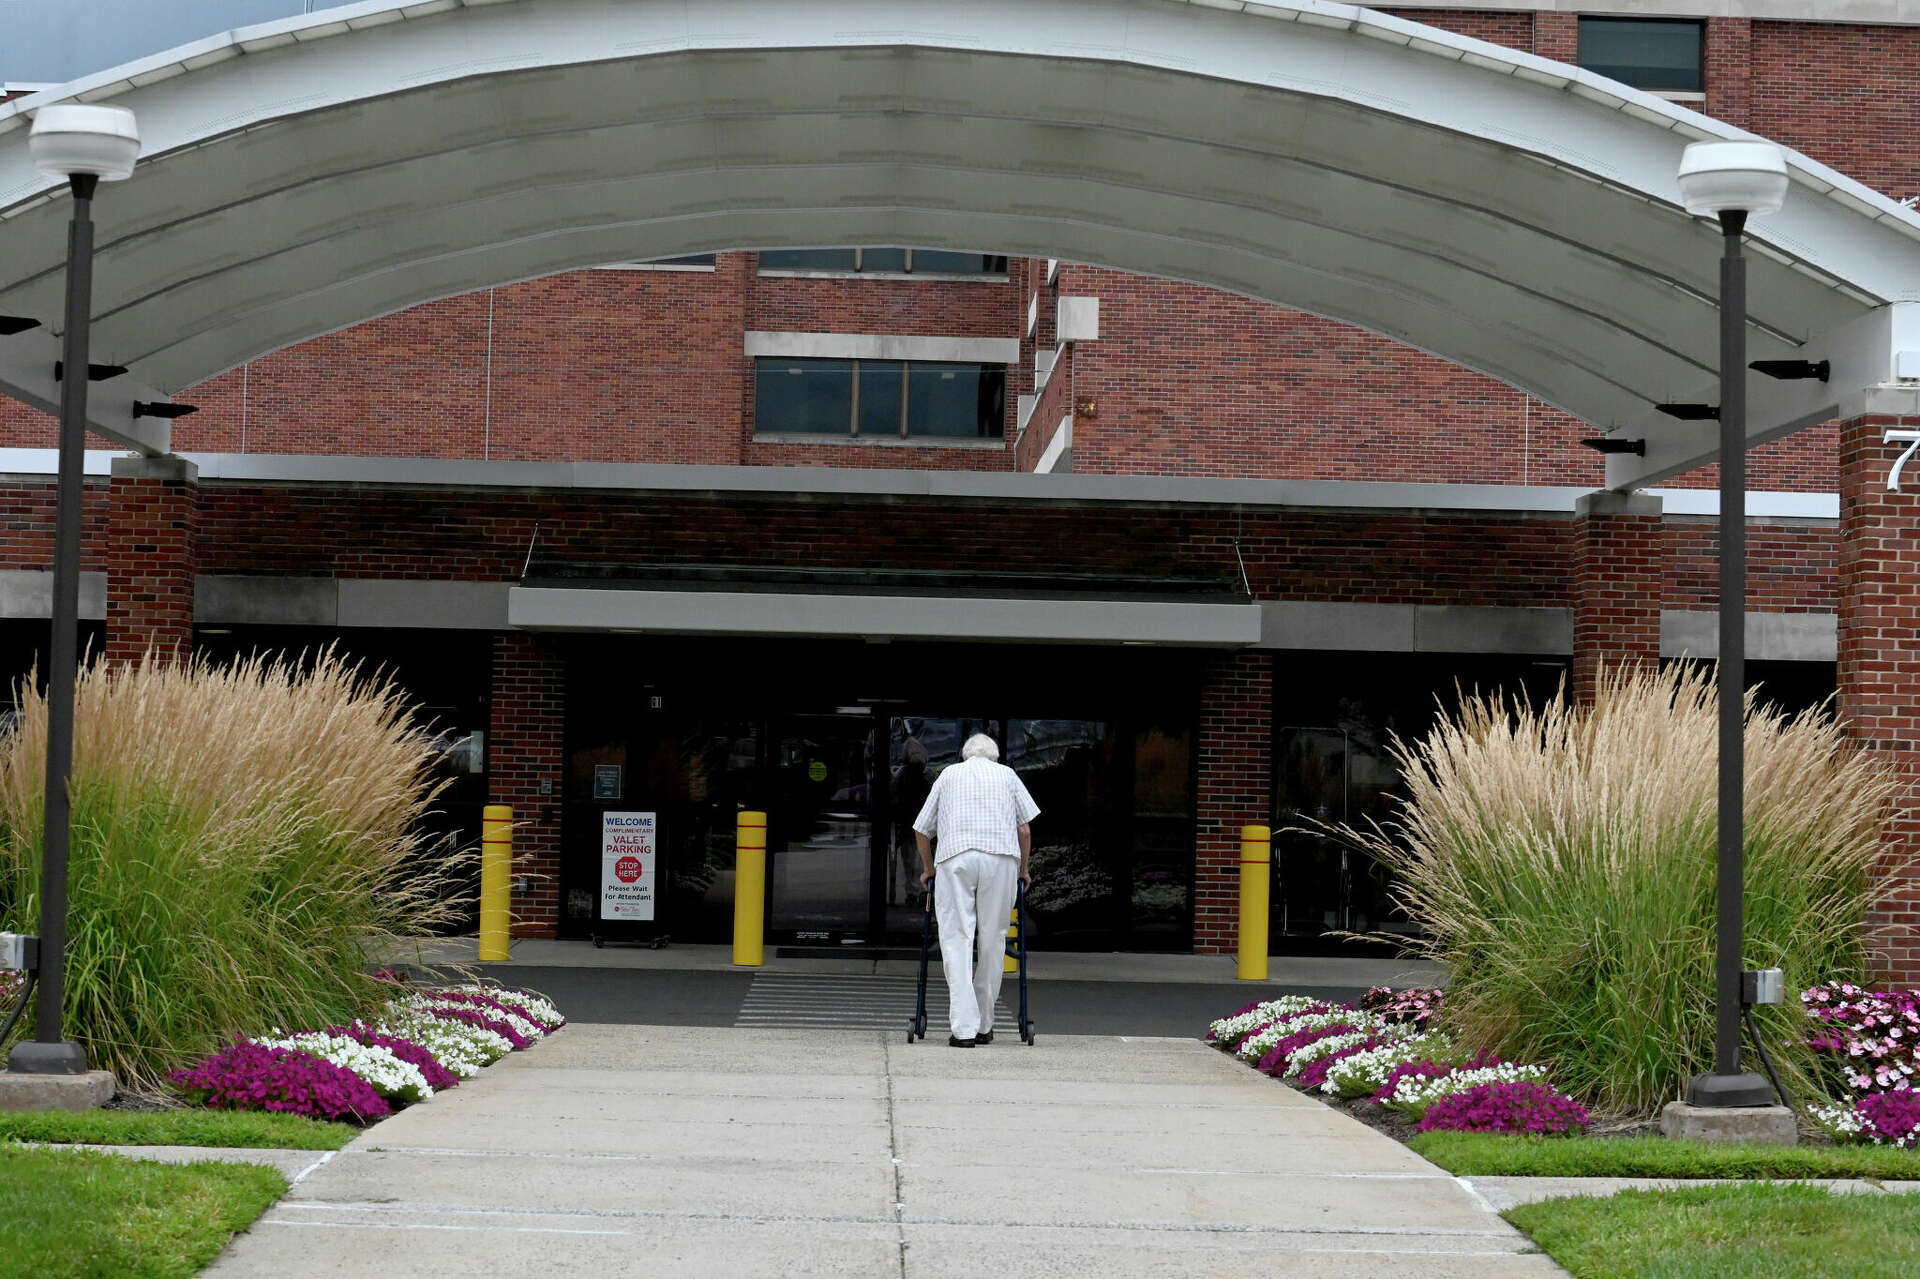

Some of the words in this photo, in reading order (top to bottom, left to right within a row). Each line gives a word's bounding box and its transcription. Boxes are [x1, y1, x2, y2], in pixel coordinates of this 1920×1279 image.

[605, 818, 652, 826] WELCOME
[613, 835, 646, 844] VALET
[606, 844, 652, 854] PARKING
